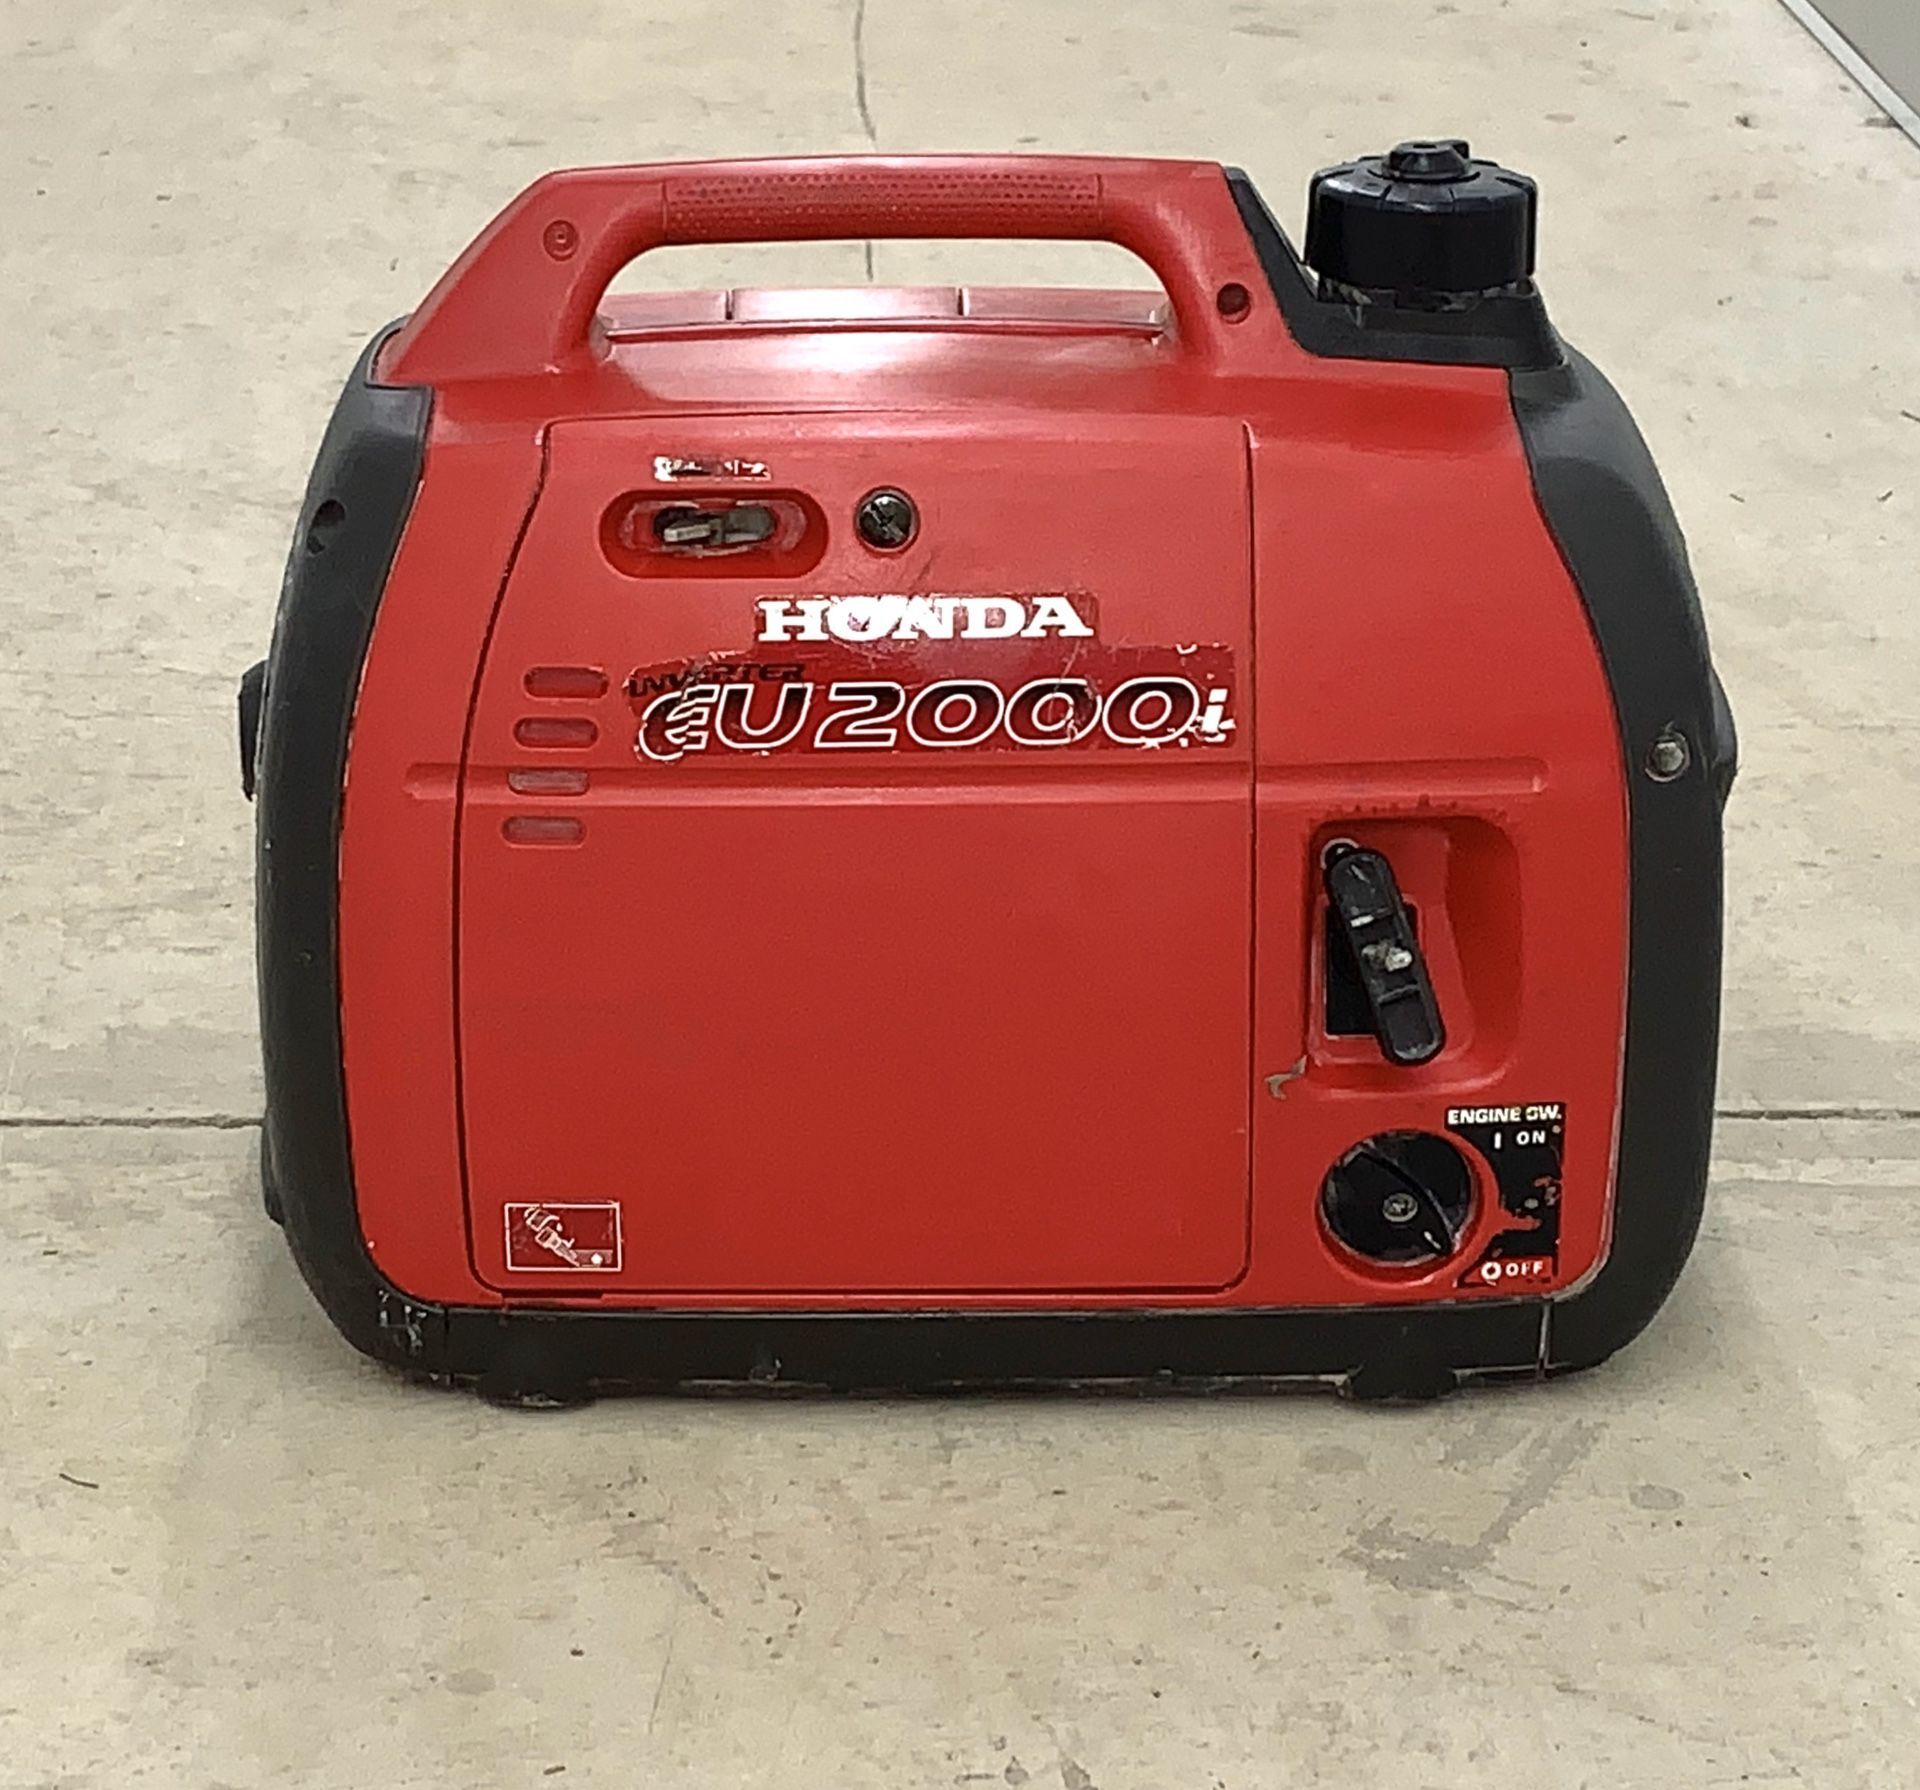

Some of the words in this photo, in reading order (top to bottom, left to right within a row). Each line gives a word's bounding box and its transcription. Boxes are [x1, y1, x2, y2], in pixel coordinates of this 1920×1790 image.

[757, 596, 1094, 641] HONDA
[1447, 1108, 1521, 1125] ENGINE
[1516, 1130, 1545, 1145] ON
[1505, 1261, 1543, 1277] OFF
